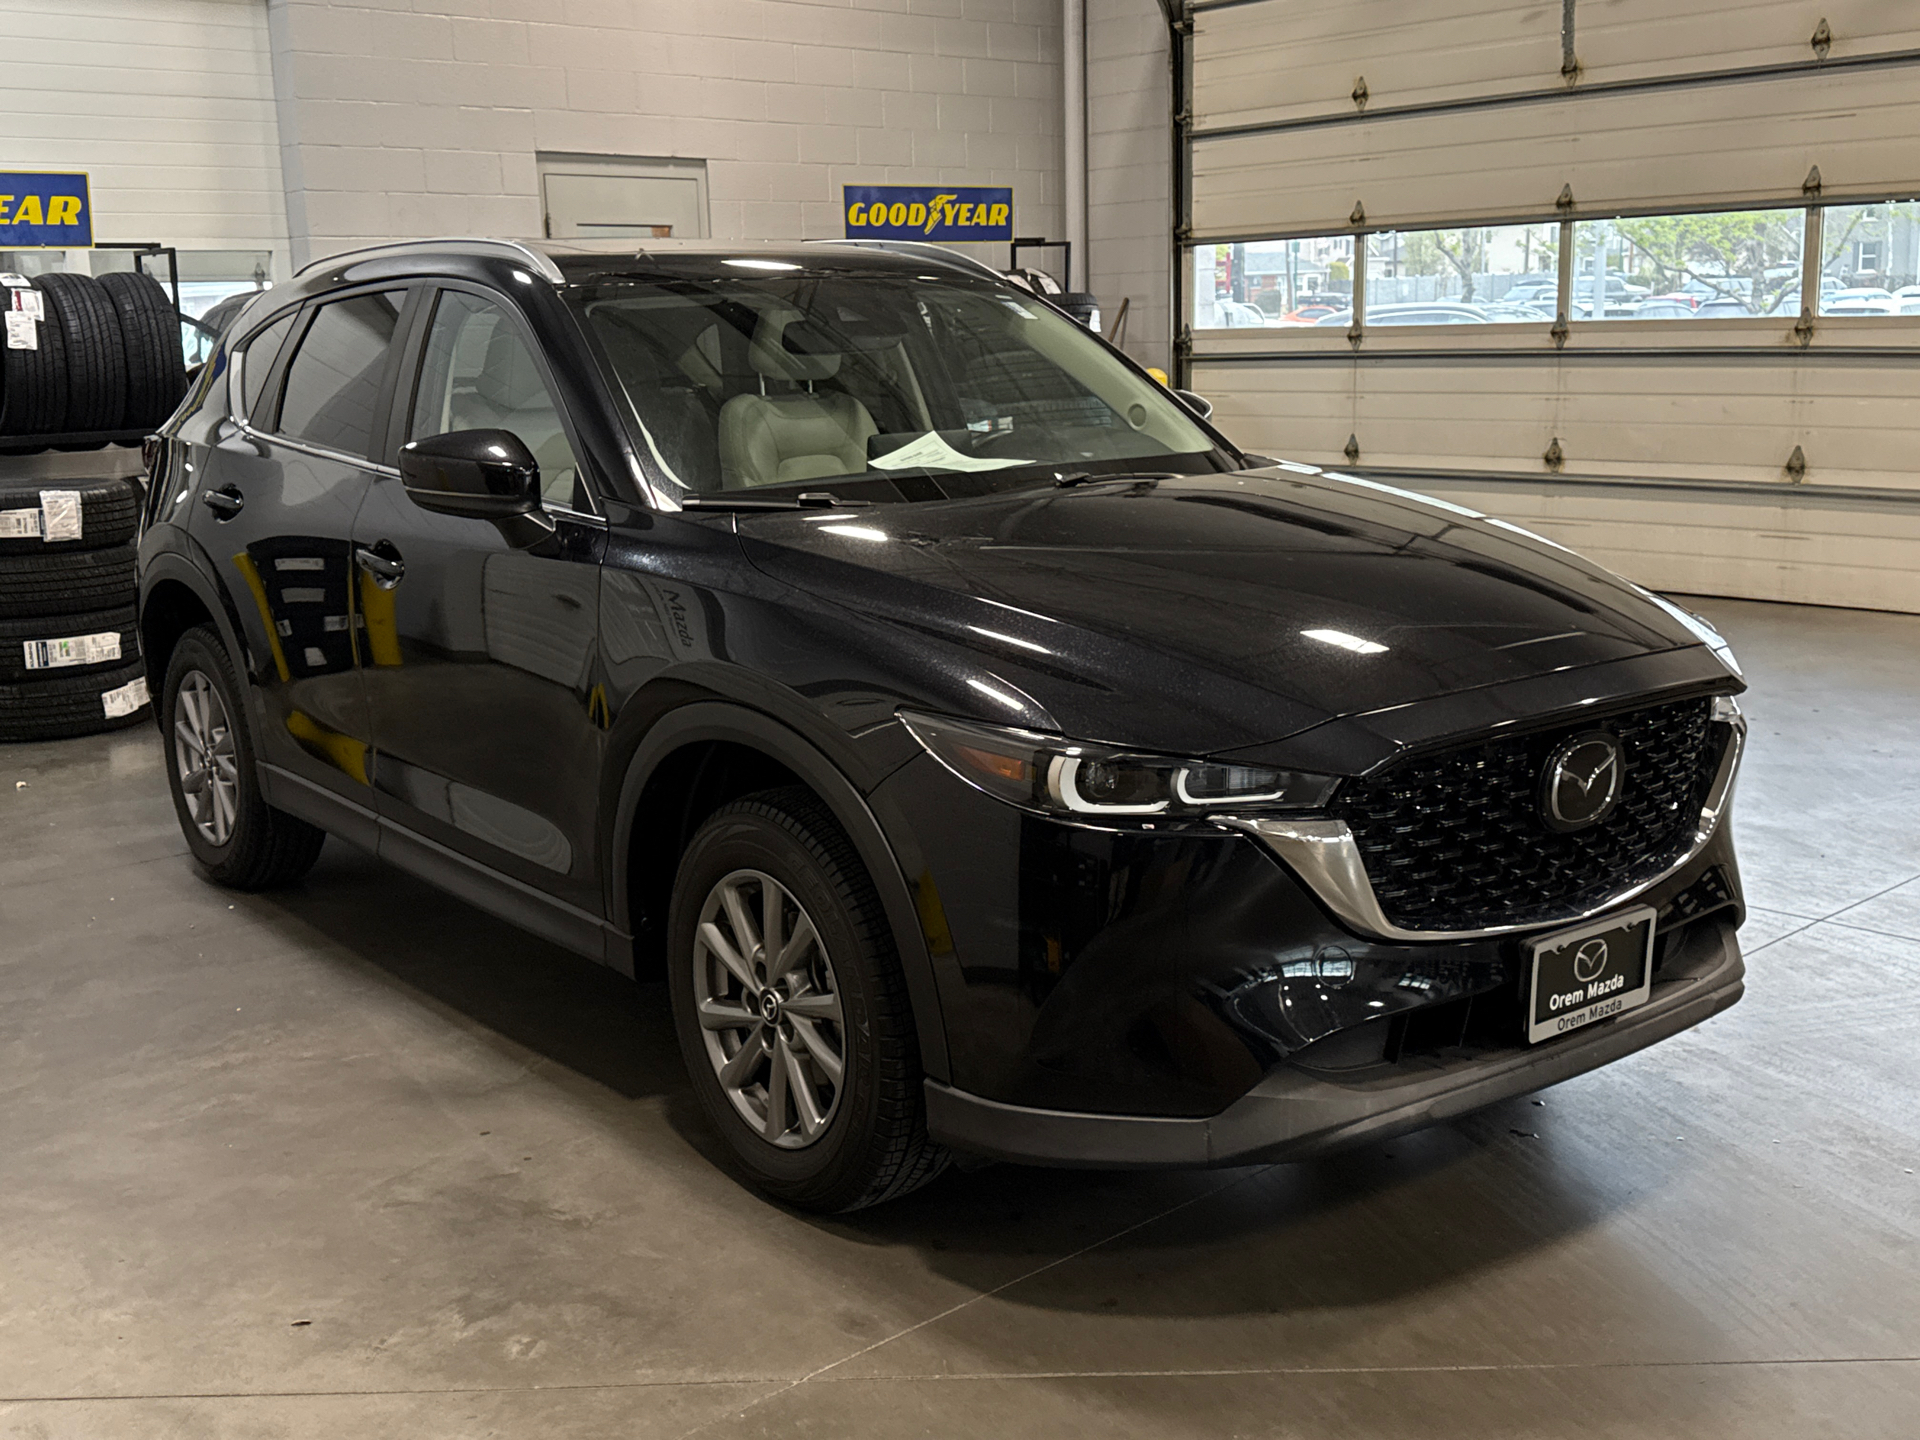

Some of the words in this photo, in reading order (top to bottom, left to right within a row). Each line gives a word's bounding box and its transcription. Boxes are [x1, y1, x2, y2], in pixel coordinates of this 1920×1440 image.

[663, 589, 694, 648] Mazda
[1549, 987, 1584, 1011] Orem
[1587, 973, 1625, 1000] Mazda
[1557, 1011, 1586, 1031] Orem
[1589, 999, 1622, 1020] Mazda
